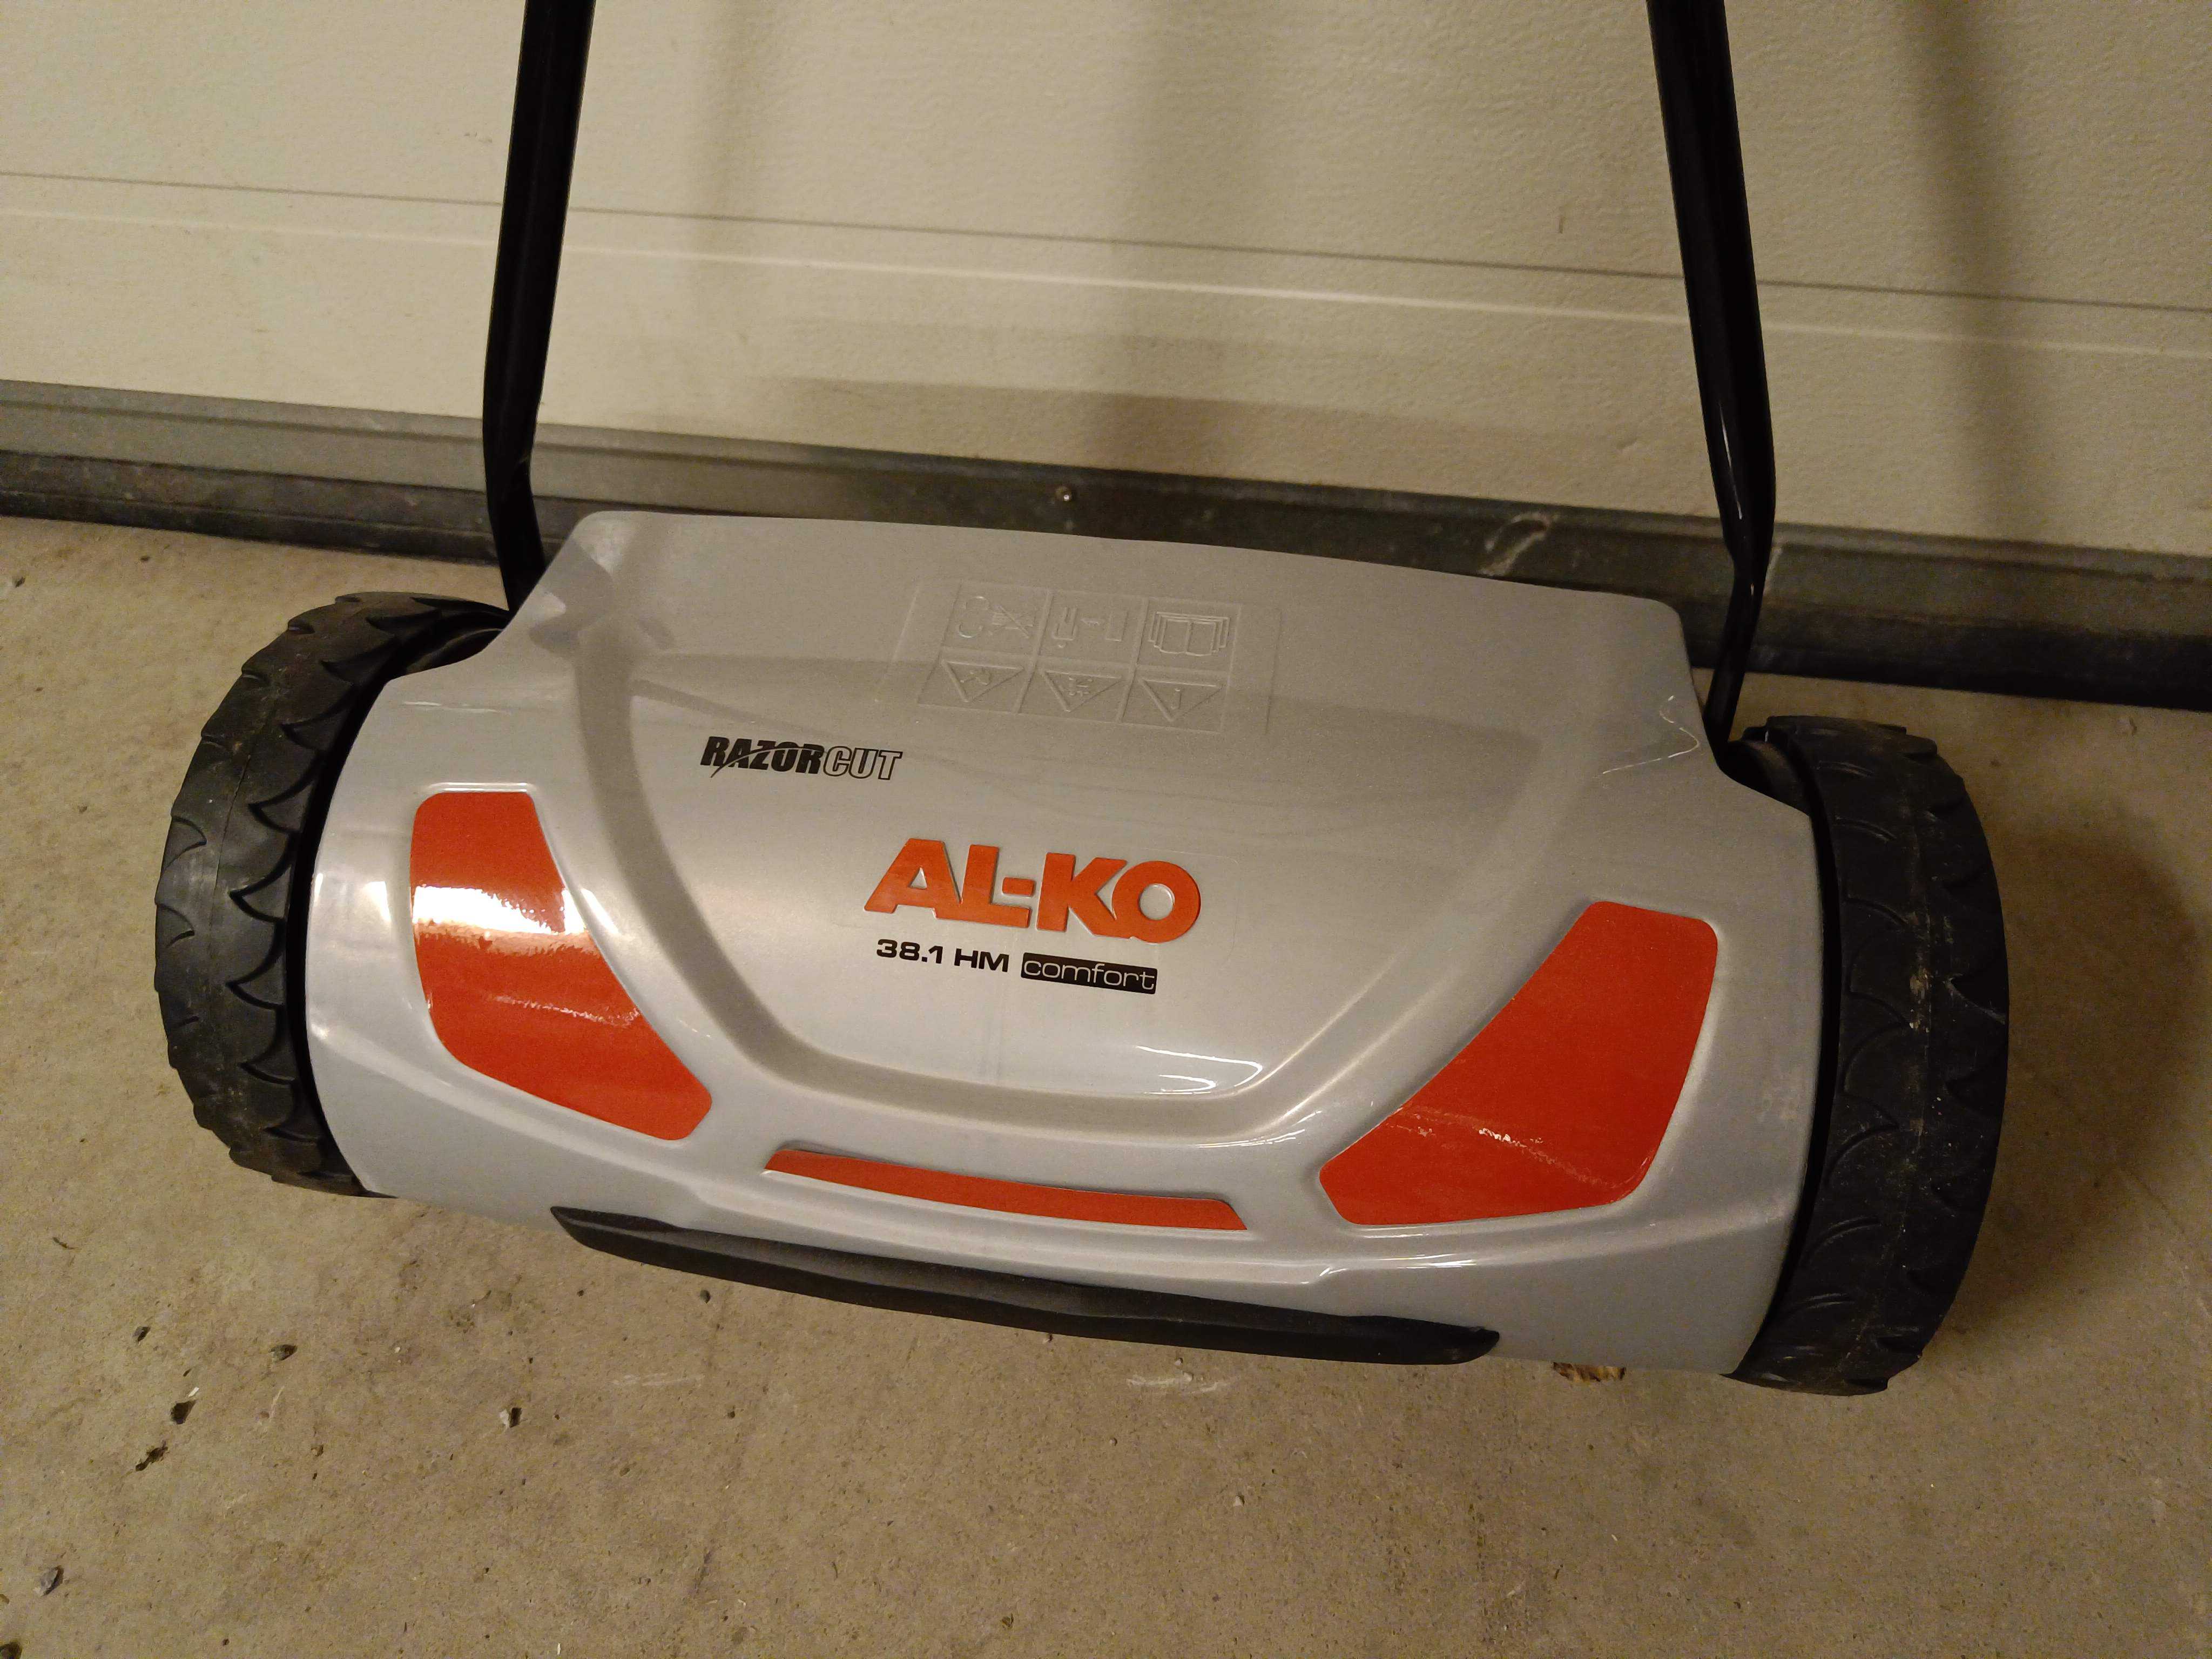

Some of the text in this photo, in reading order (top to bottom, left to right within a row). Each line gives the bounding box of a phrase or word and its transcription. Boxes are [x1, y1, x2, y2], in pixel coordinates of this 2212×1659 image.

[864, 838, 1202, 943] AL-KO
[876, 939, 1155, 990] 38.1 HM comfort
